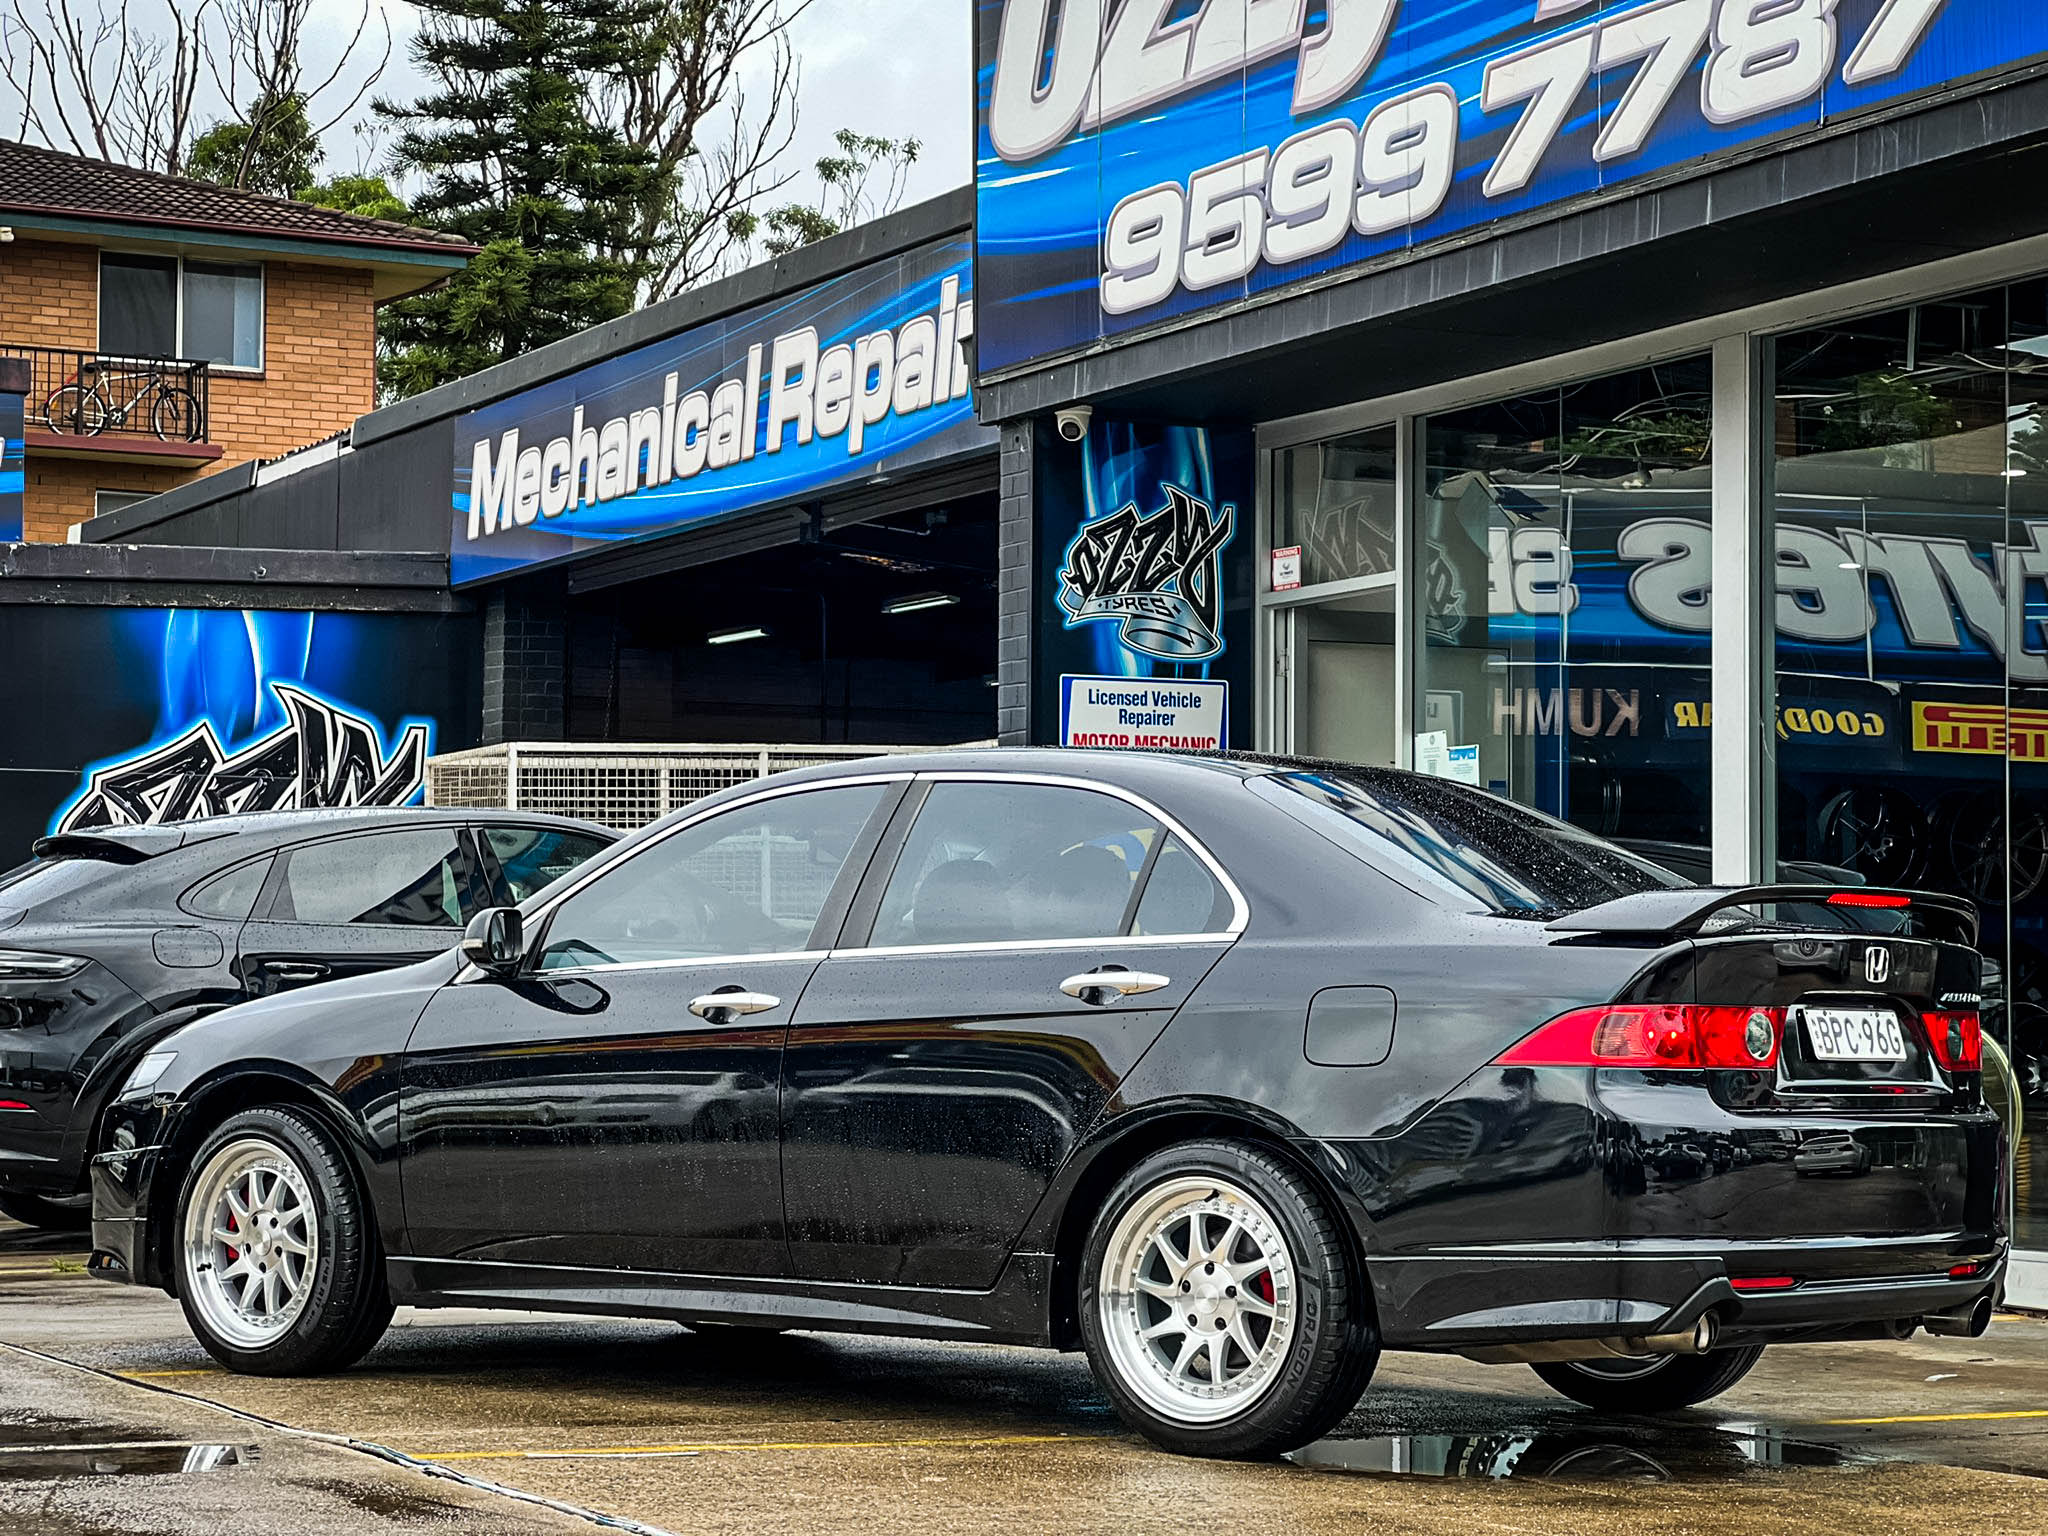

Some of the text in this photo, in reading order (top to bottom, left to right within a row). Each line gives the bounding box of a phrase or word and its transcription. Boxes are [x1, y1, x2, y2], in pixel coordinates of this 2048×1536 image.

[1099, 84, 1459, 315] 9599
[466, 342, 763, 541] Mechanical
[1103, 597, 1176, 619] TYRES
[1088, 689, 1202, 708] Licensed Vehicle
[1118, 708, 1176, 728] Repairer
[1073, 733, 1216, 749] MOTOR MECHANIC
[1286, 1301, 1317, 1389] DRAGON
